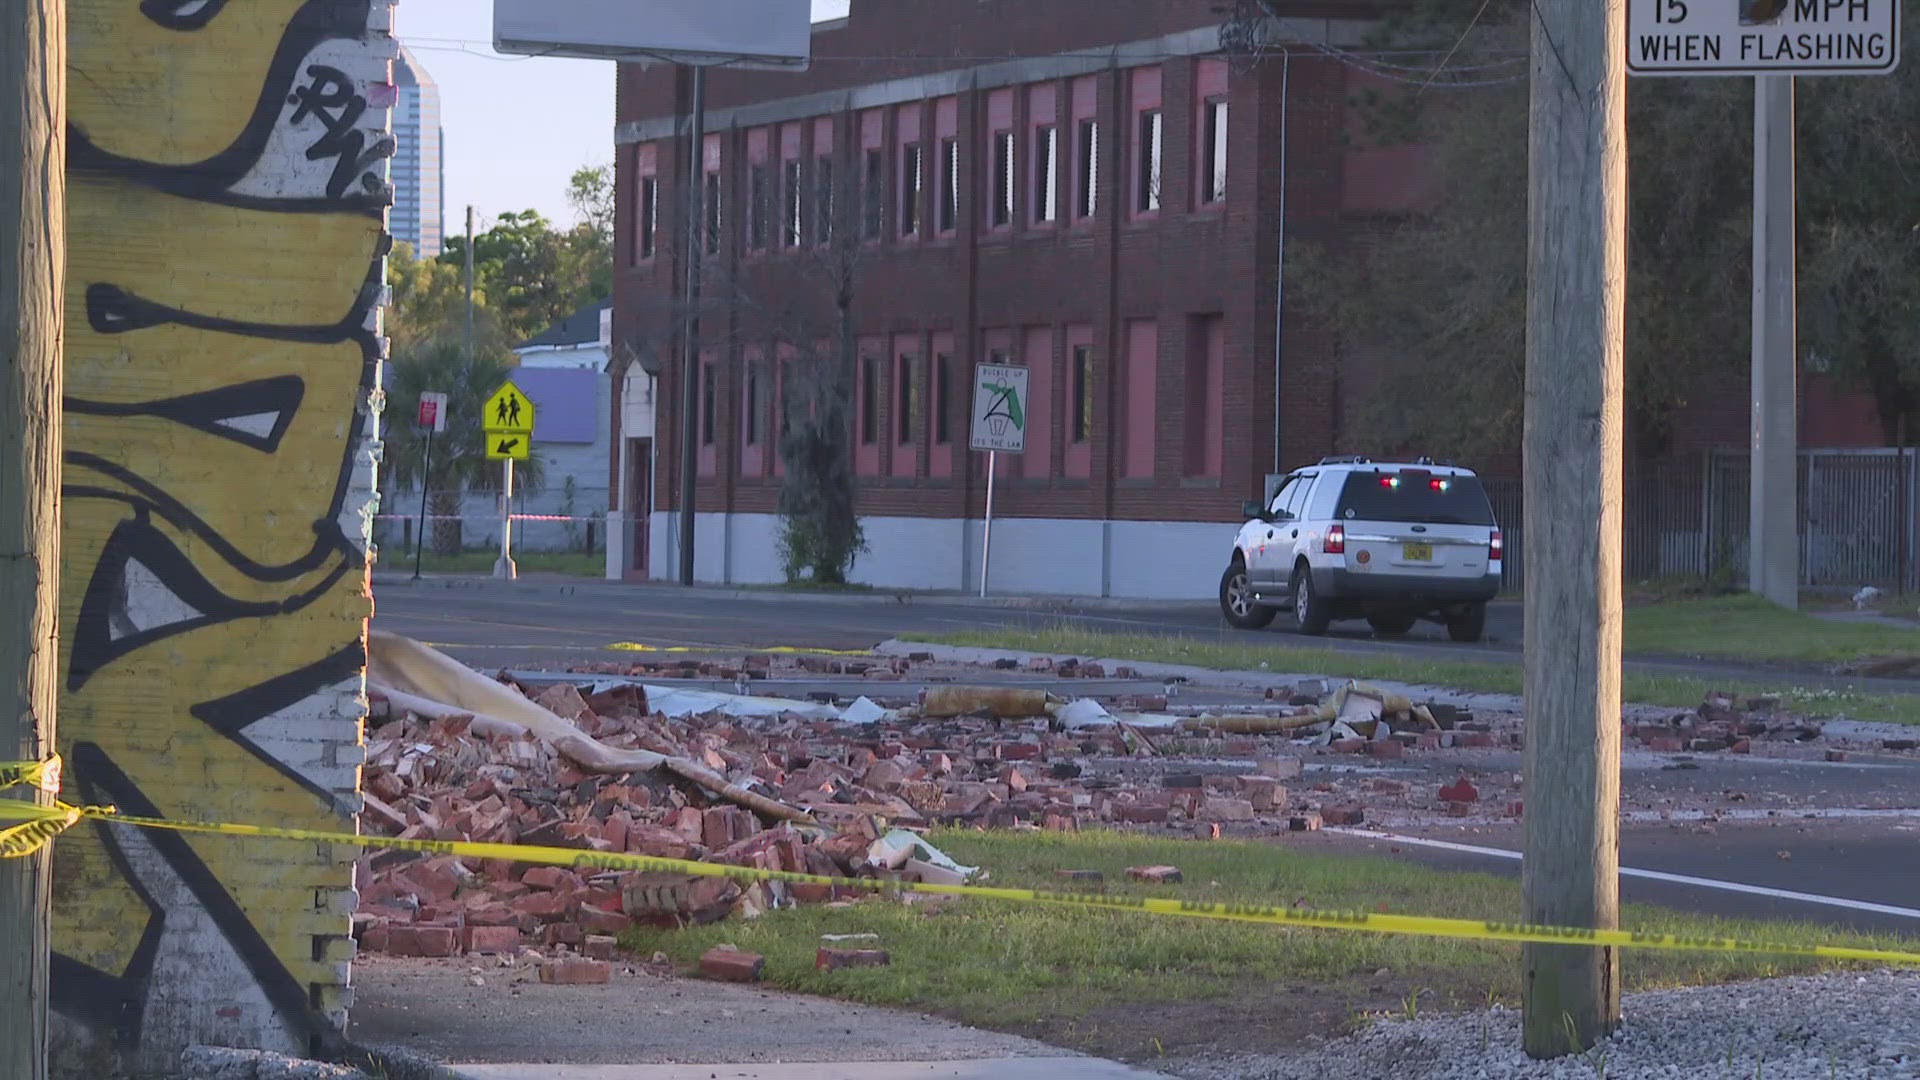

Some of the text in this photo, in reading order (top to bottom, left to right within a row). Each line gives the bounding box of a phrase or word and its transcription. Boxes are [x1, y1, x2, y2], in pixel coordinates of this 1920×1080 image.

[1654, 0, 1869, 24] 15 MPH
[1640, 33, 1885, 61] WHEN FLASHING
